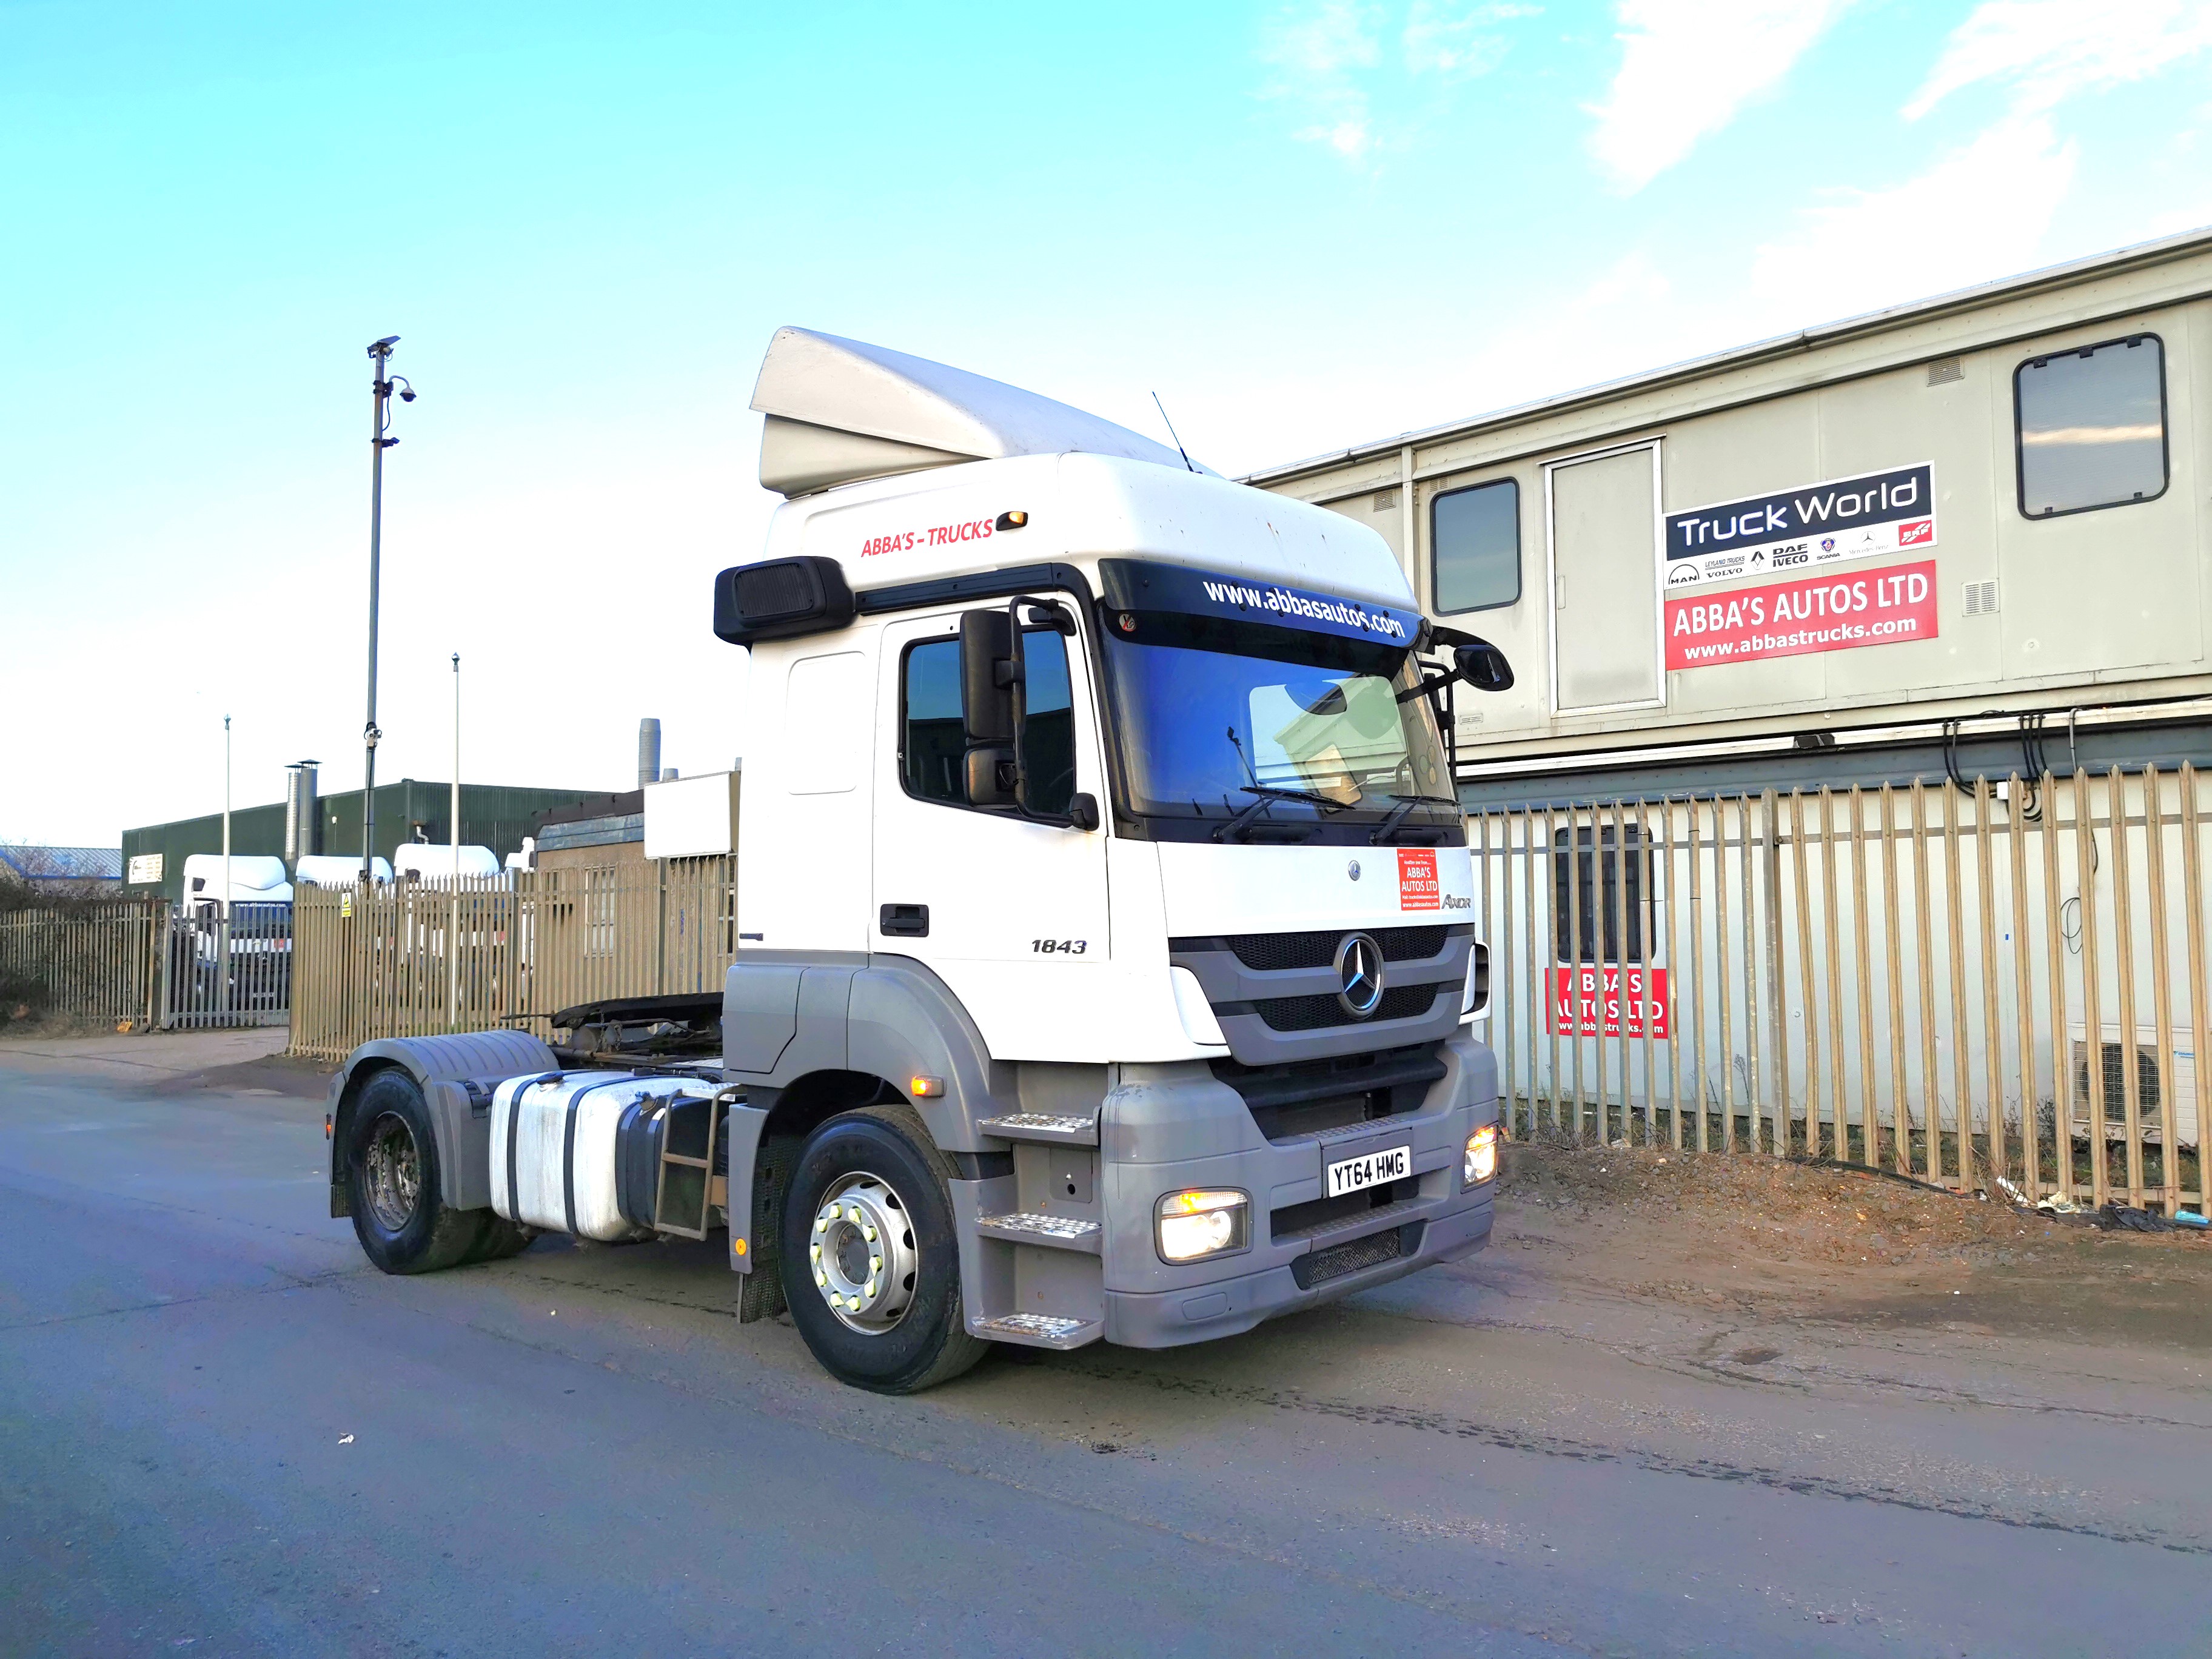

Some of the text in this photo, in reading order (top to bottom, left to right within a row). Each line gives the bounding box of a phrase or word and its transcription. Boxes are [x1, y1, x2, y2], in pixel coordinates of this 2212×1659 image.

[1677, 476, 1918, 546] Truck World
[1772, 543, 1808, 555] DAF
[1705, 555, 1746, 568] LEYLAND TRUCKS
[1772, 554, 1809, 568] IVECO
[1671, 575, 1698, 585] MAN
[1706, 568, 1743, 578] VOLVO
[1202, 581, 1406, 638] www.abbasautos.com
[1673, 573, 1928, 637] ABBA'S AUTOS LTD
[1684, 617, 1917, 660] www.abbastrucks.com
[1407, 866, 1431, 878] ABBA'S
[1402, 880, 1438, 892] AUTOS LTD
[1032, 939, 1088, 954] 1843
[1334, 1151, 1404, 1190] YT64 HMG
